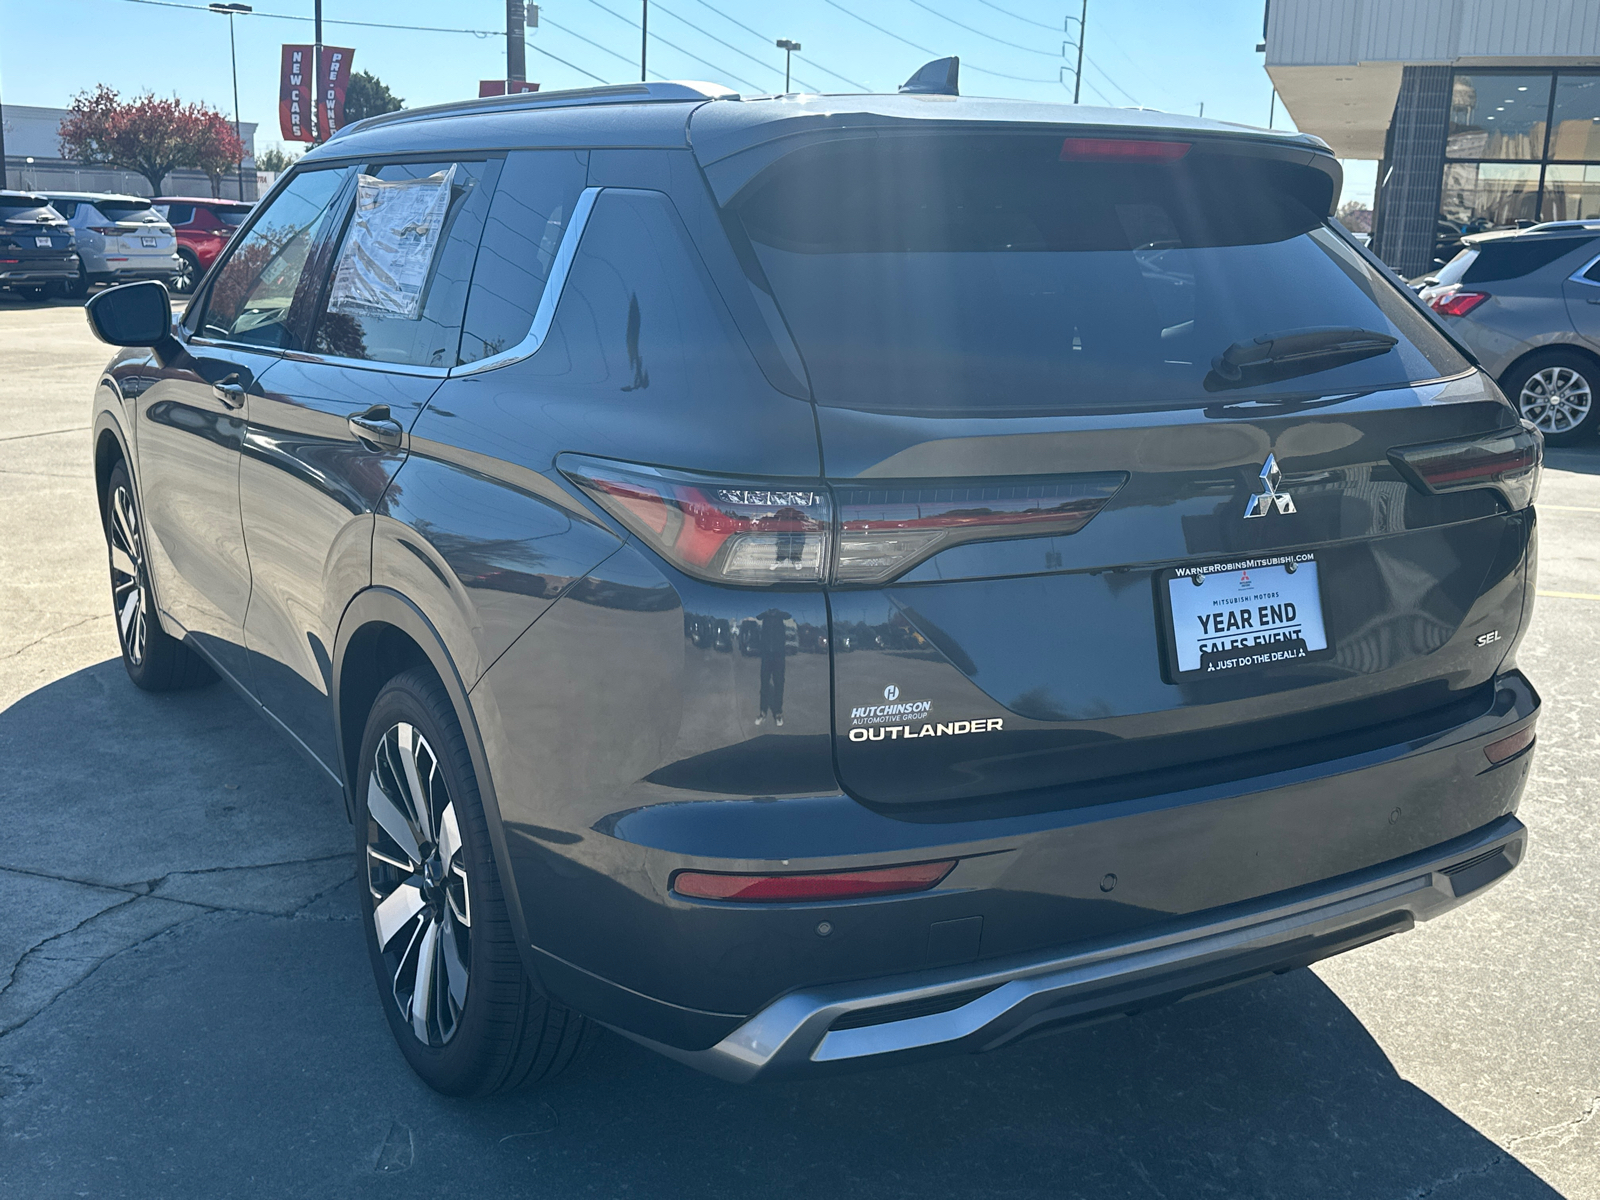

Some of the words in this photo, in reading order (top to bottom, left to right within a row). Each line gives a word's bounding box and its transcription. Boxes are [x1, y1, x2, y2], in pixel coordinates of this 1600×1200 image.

[290, 51, 302, 85] NEW
[291, 90, 302, 136] CARS
[1212, 596, 1252, 605] MITSUBISHI
[1253, 591, 1280, 600] MOTORS
[1197, 609, 1254, 634] YEAR
[1258, 602, 1296, 626] END
[1475, 630, 1502, 647] SEL
[1216, 658, 1238, 671] JUST
[1238, 656, 1252, 667] DO
[1252, 653, 1271, 665] THE
[1271, 649, 1298, 660] DEAL!
[850, 701, 930, 718] HUTCHINSON
[852, 714, 901, 725] AUTOMOTIVE
[902, 711, 928, 720] GROUP
[848, 717, 1003, 742] OUTLANDER
